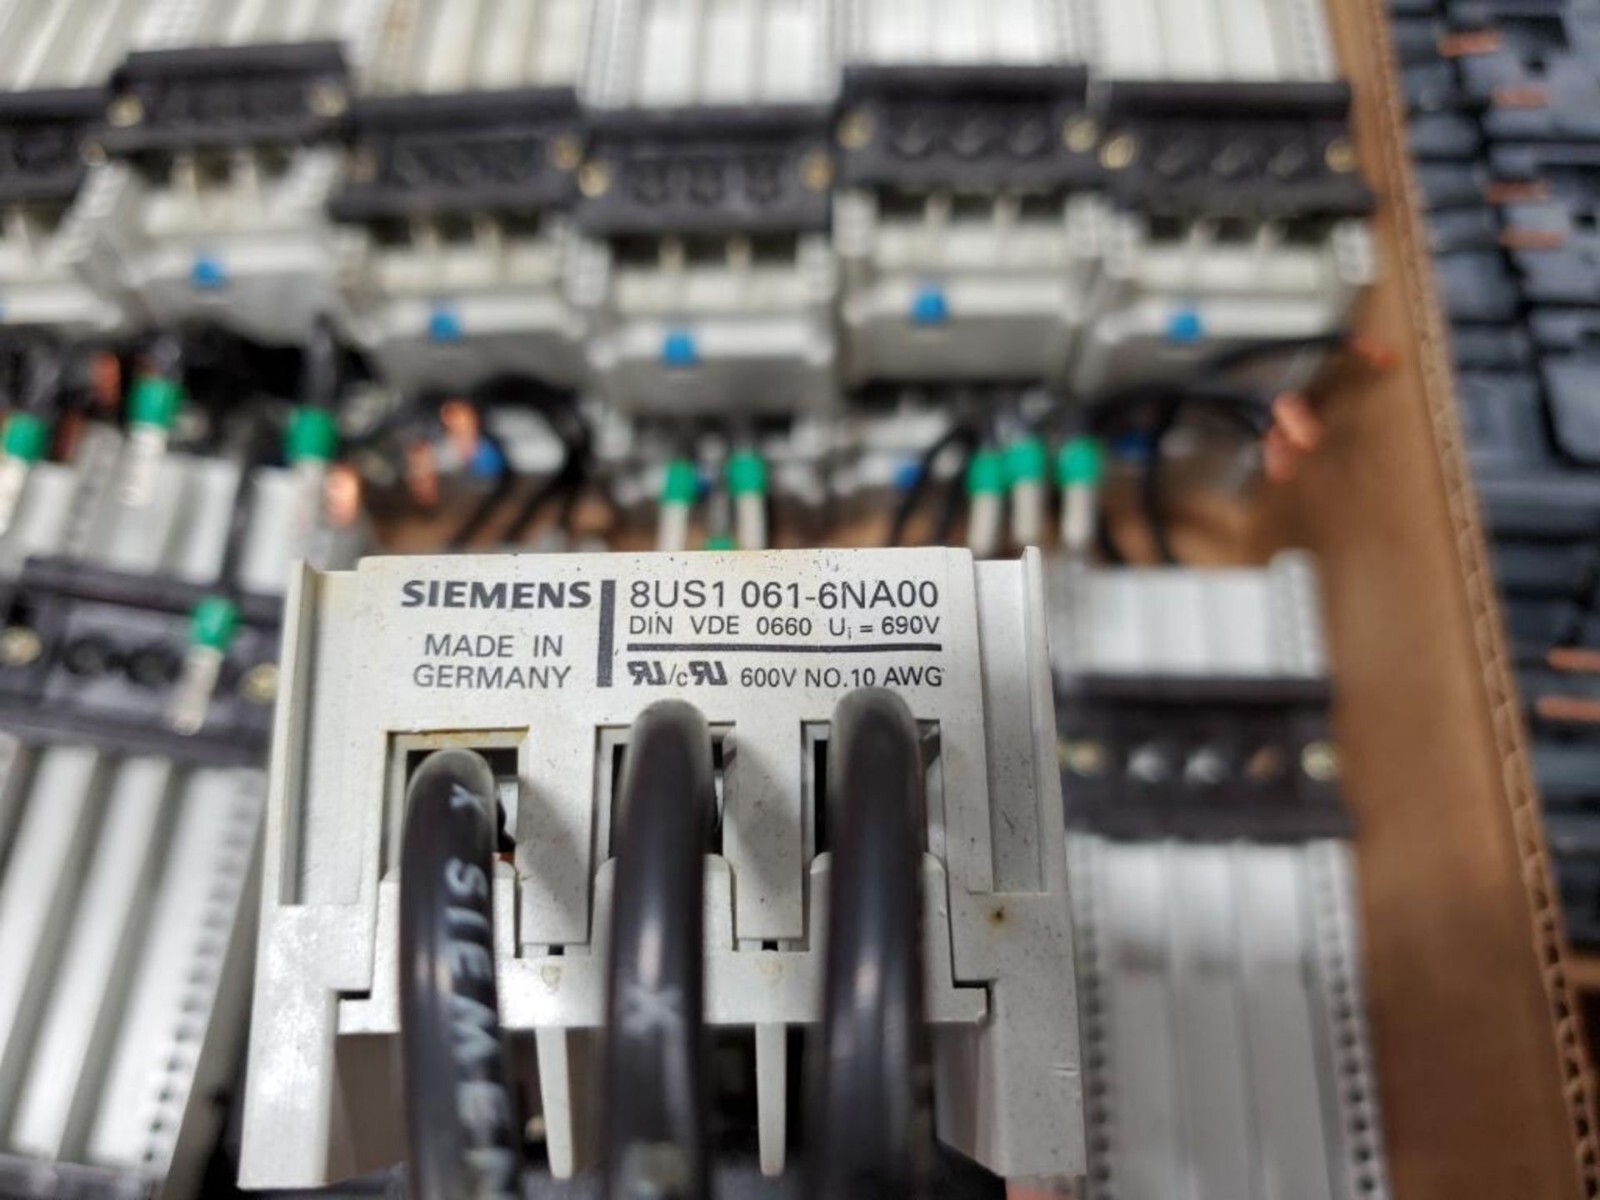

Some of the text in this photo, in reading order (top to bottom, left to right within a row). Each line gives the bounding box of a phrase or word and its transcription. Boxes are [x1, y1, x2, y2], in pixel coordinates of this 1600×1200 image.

[401, 579, 592, 609] SIEMENS
[630, 579, 939, 609] 8US1 061-6NA00
[629, 615, 673, 635] DIN
[690, 615, 740, 635] VDE
[756, 616, 813, 636] 0660
[881, 615, 941, 635] 690V
[424, 634, 564, 658] MADE IN
[413, 664, 572, 689] GERMANY
[741, 667, 797, 688] 600V
[882, 667, 943, 687] AWG
